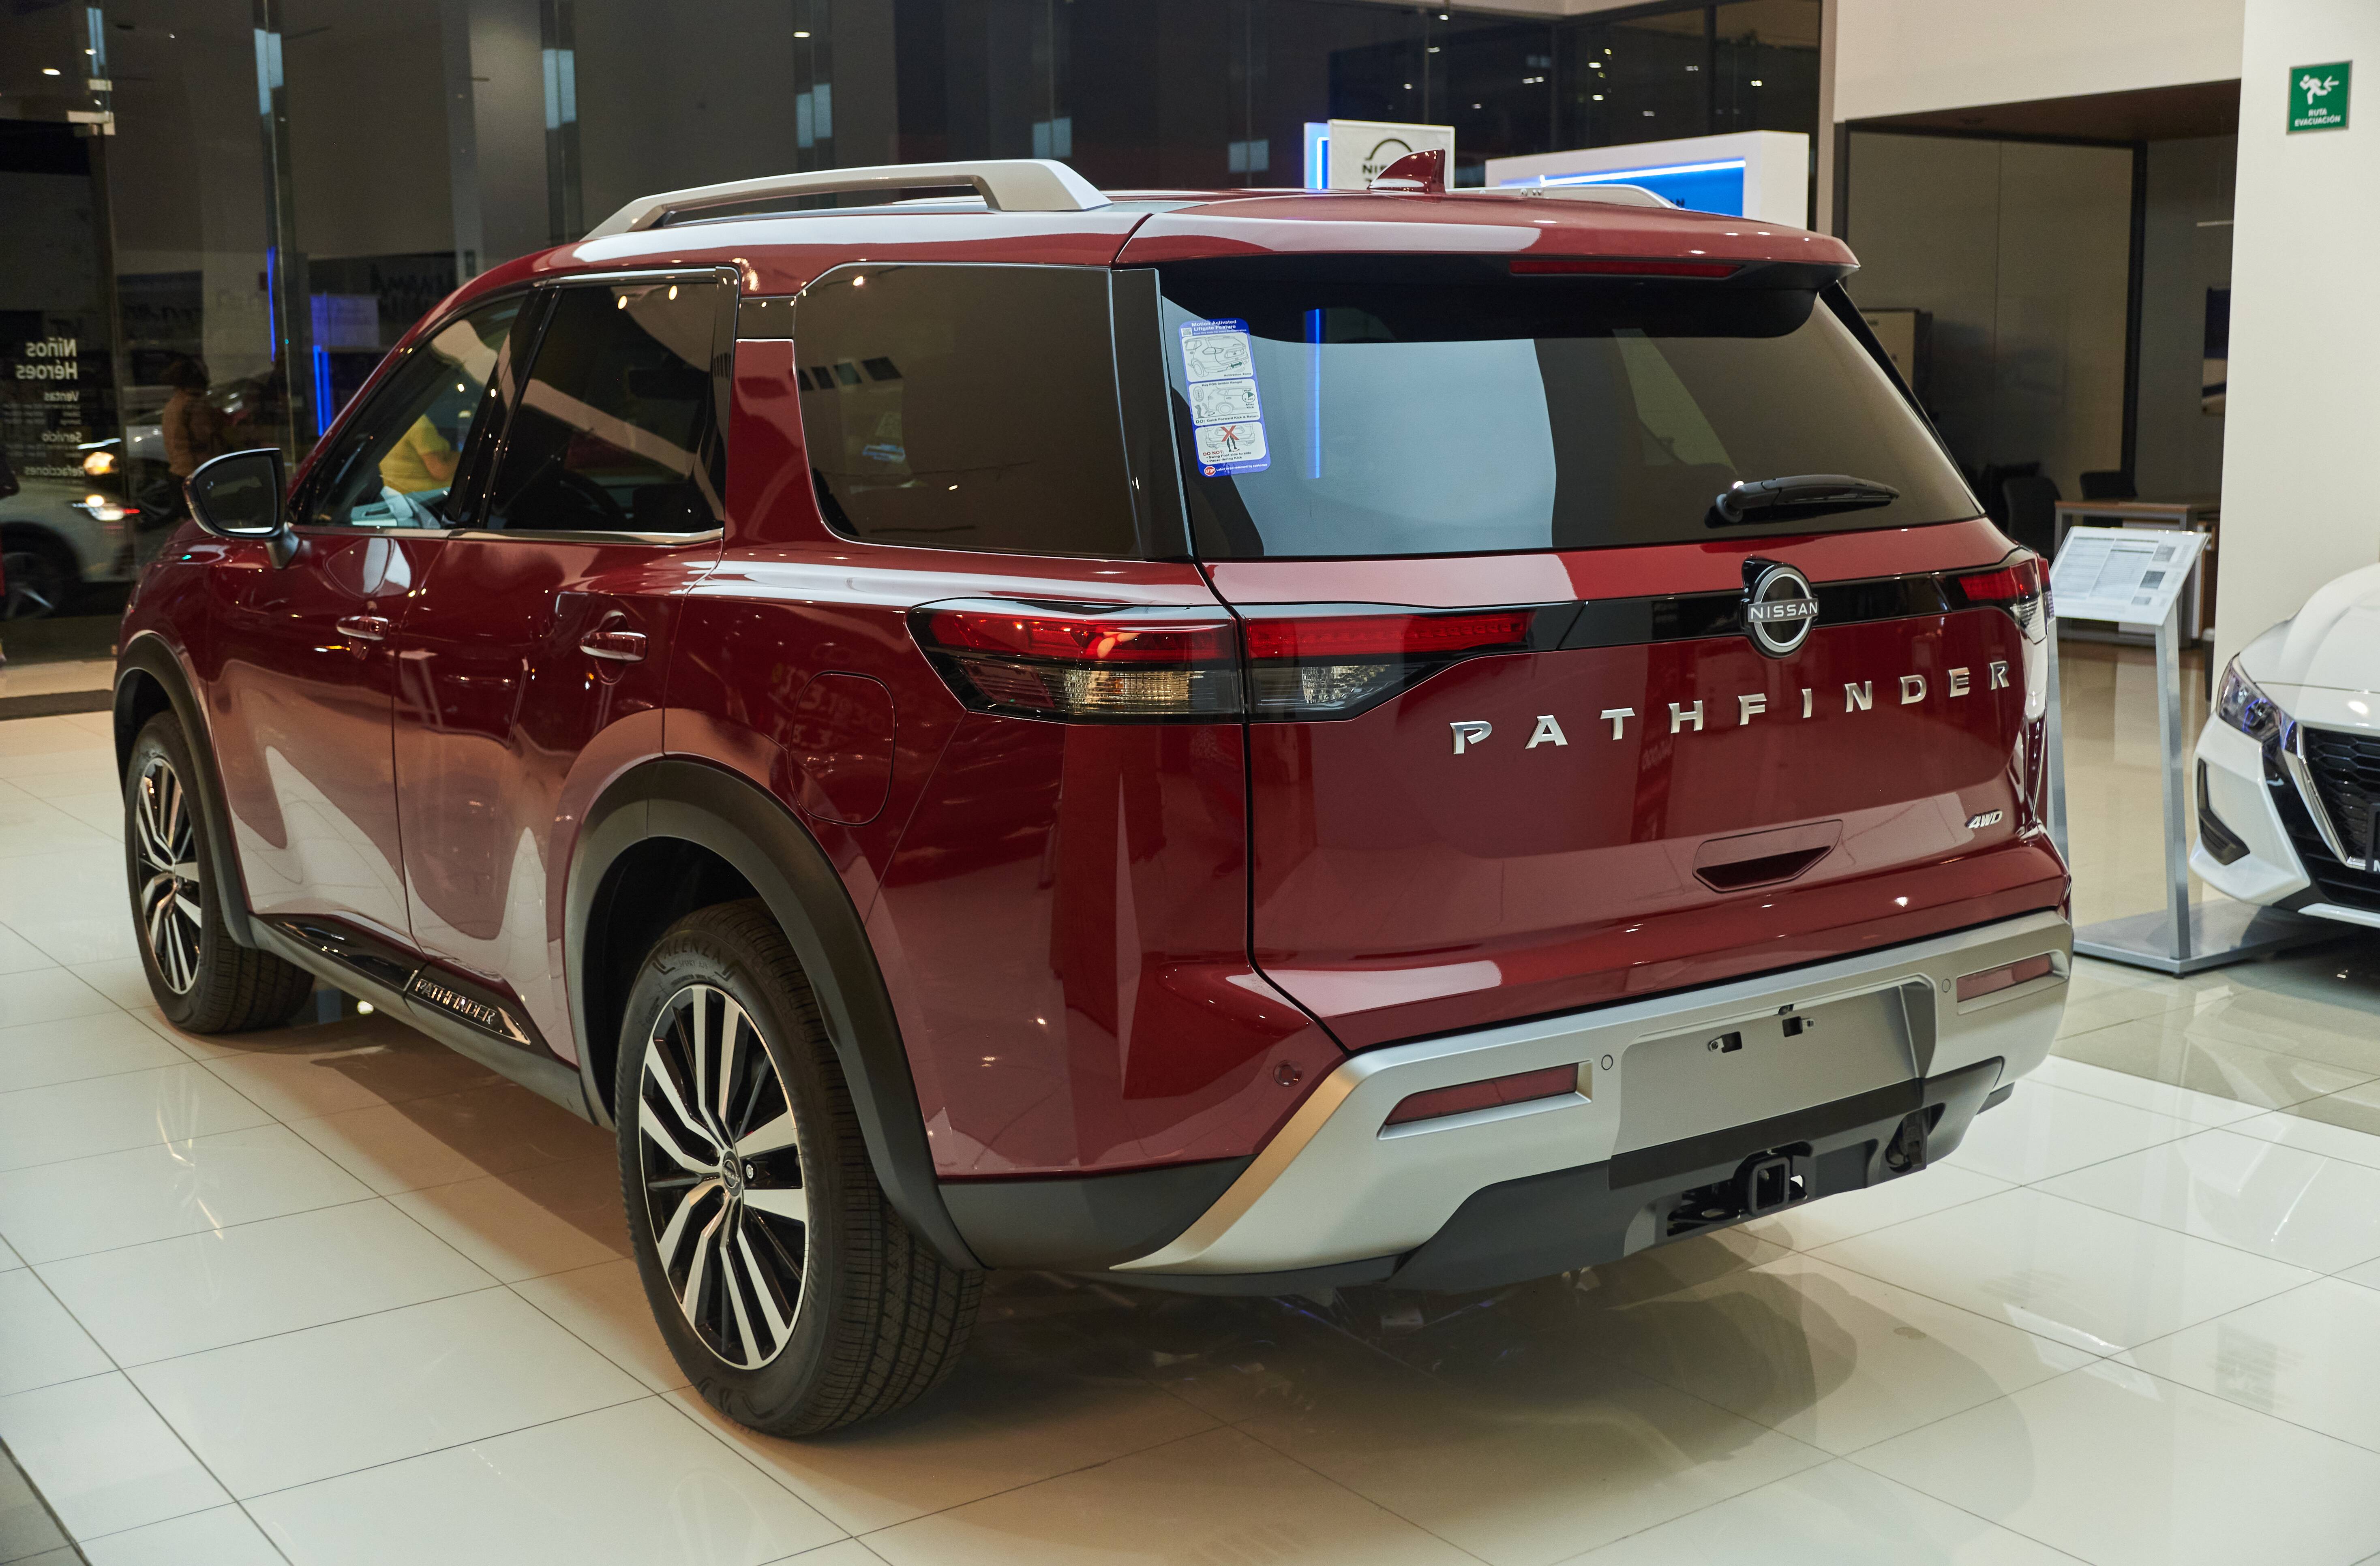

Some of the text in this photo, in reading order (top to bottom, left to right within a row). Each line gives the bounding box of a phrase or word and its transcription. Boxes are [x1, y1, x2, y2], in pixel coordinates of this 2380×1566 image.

[2294, 114, 2341, 126] EVACUACIÓN
[2308, 108, 2327, 117] RUTA
[1751, 601, 1817, 620] NISSAN
[1450, 660, 2009, 754] PATHFINDER
[1967, 809, 2003, 829] 4WD
[663, 937, 721, 965] ALENZA
[415, 978, 497, 1024] PATHFINDER
